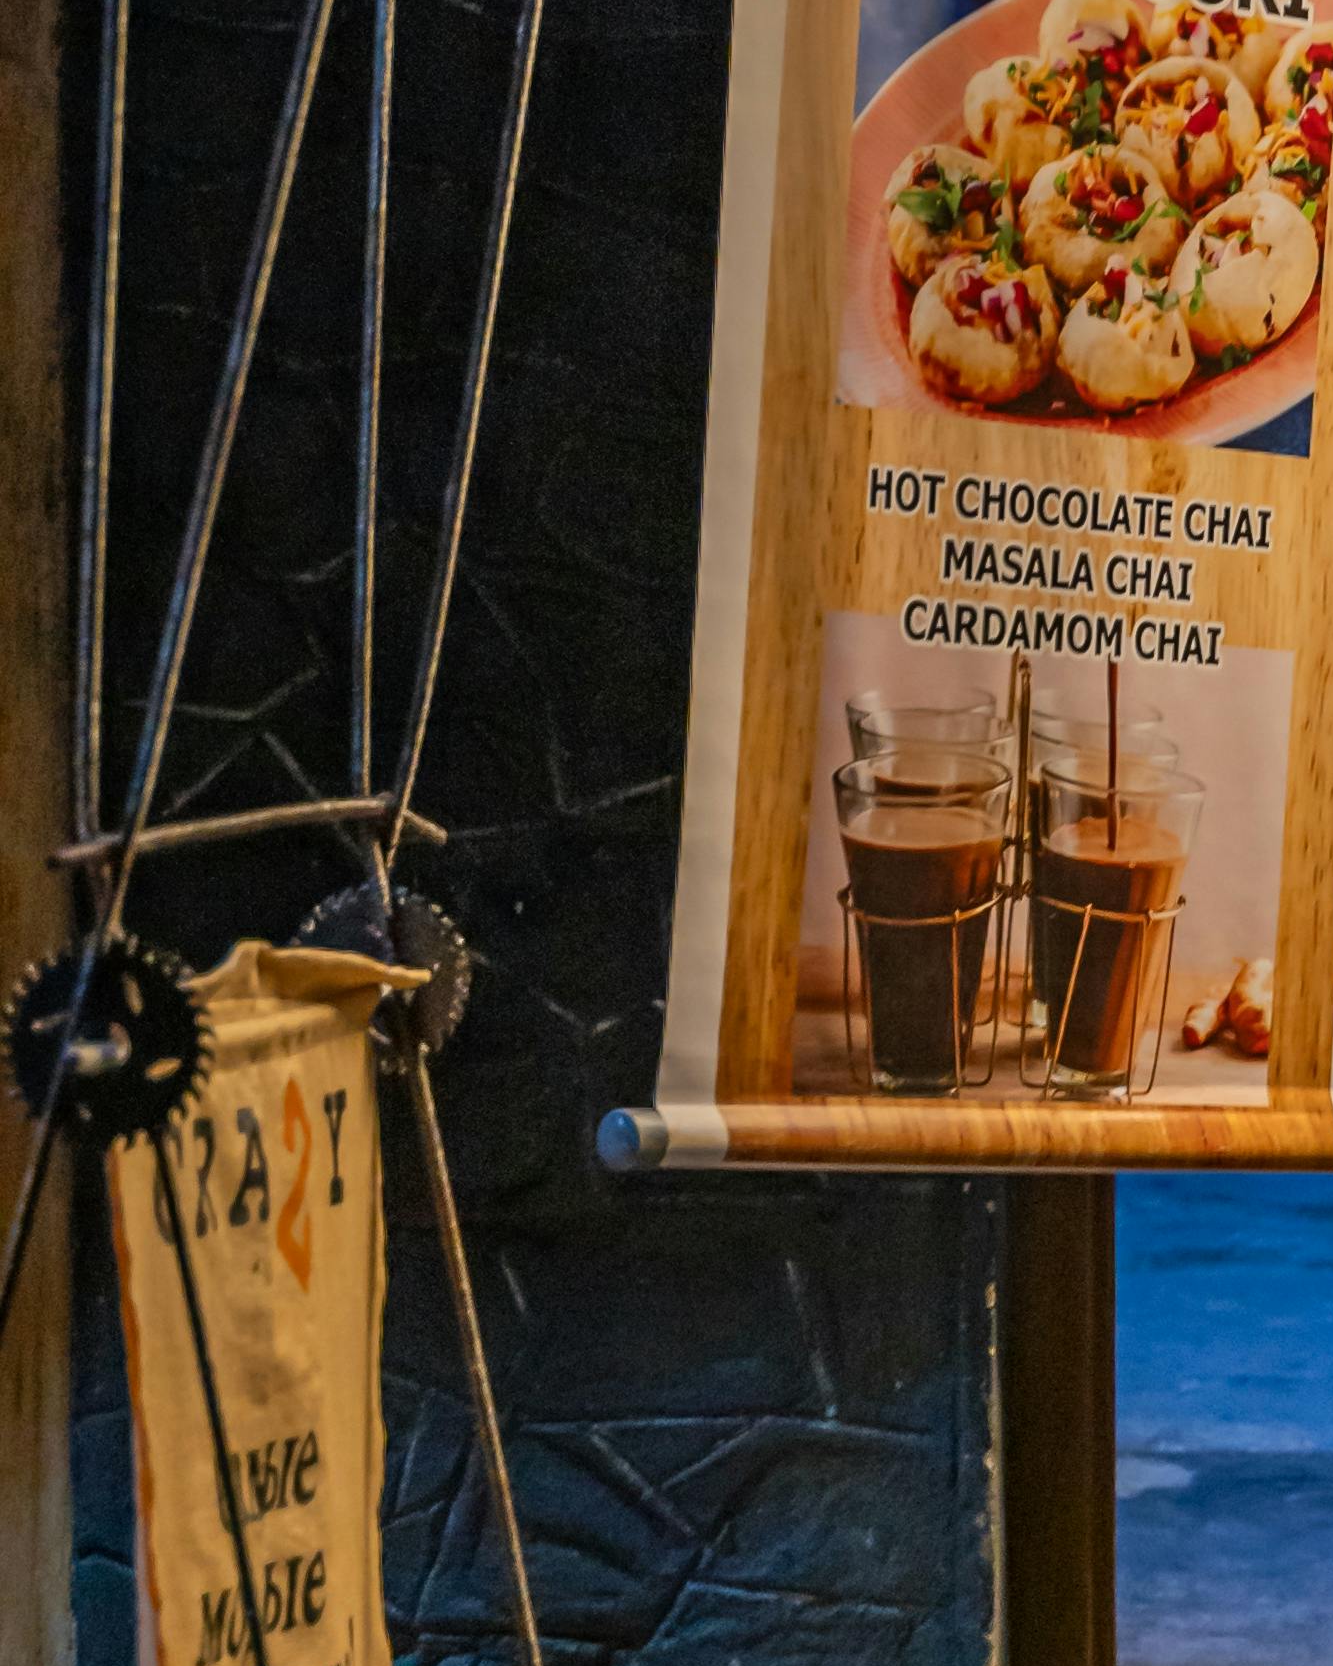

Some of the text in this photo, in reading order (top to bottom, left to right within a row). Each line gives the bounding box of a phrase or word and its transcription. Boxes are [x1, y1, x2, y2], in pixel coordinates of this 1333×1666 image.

[868, 468, 1273, 549] HOT CHOCOLATE CHAI
[943, 541, 1193, 602] MASALA CHAI
[902, 601, 1223, 667] CARDAMOM CHAI
